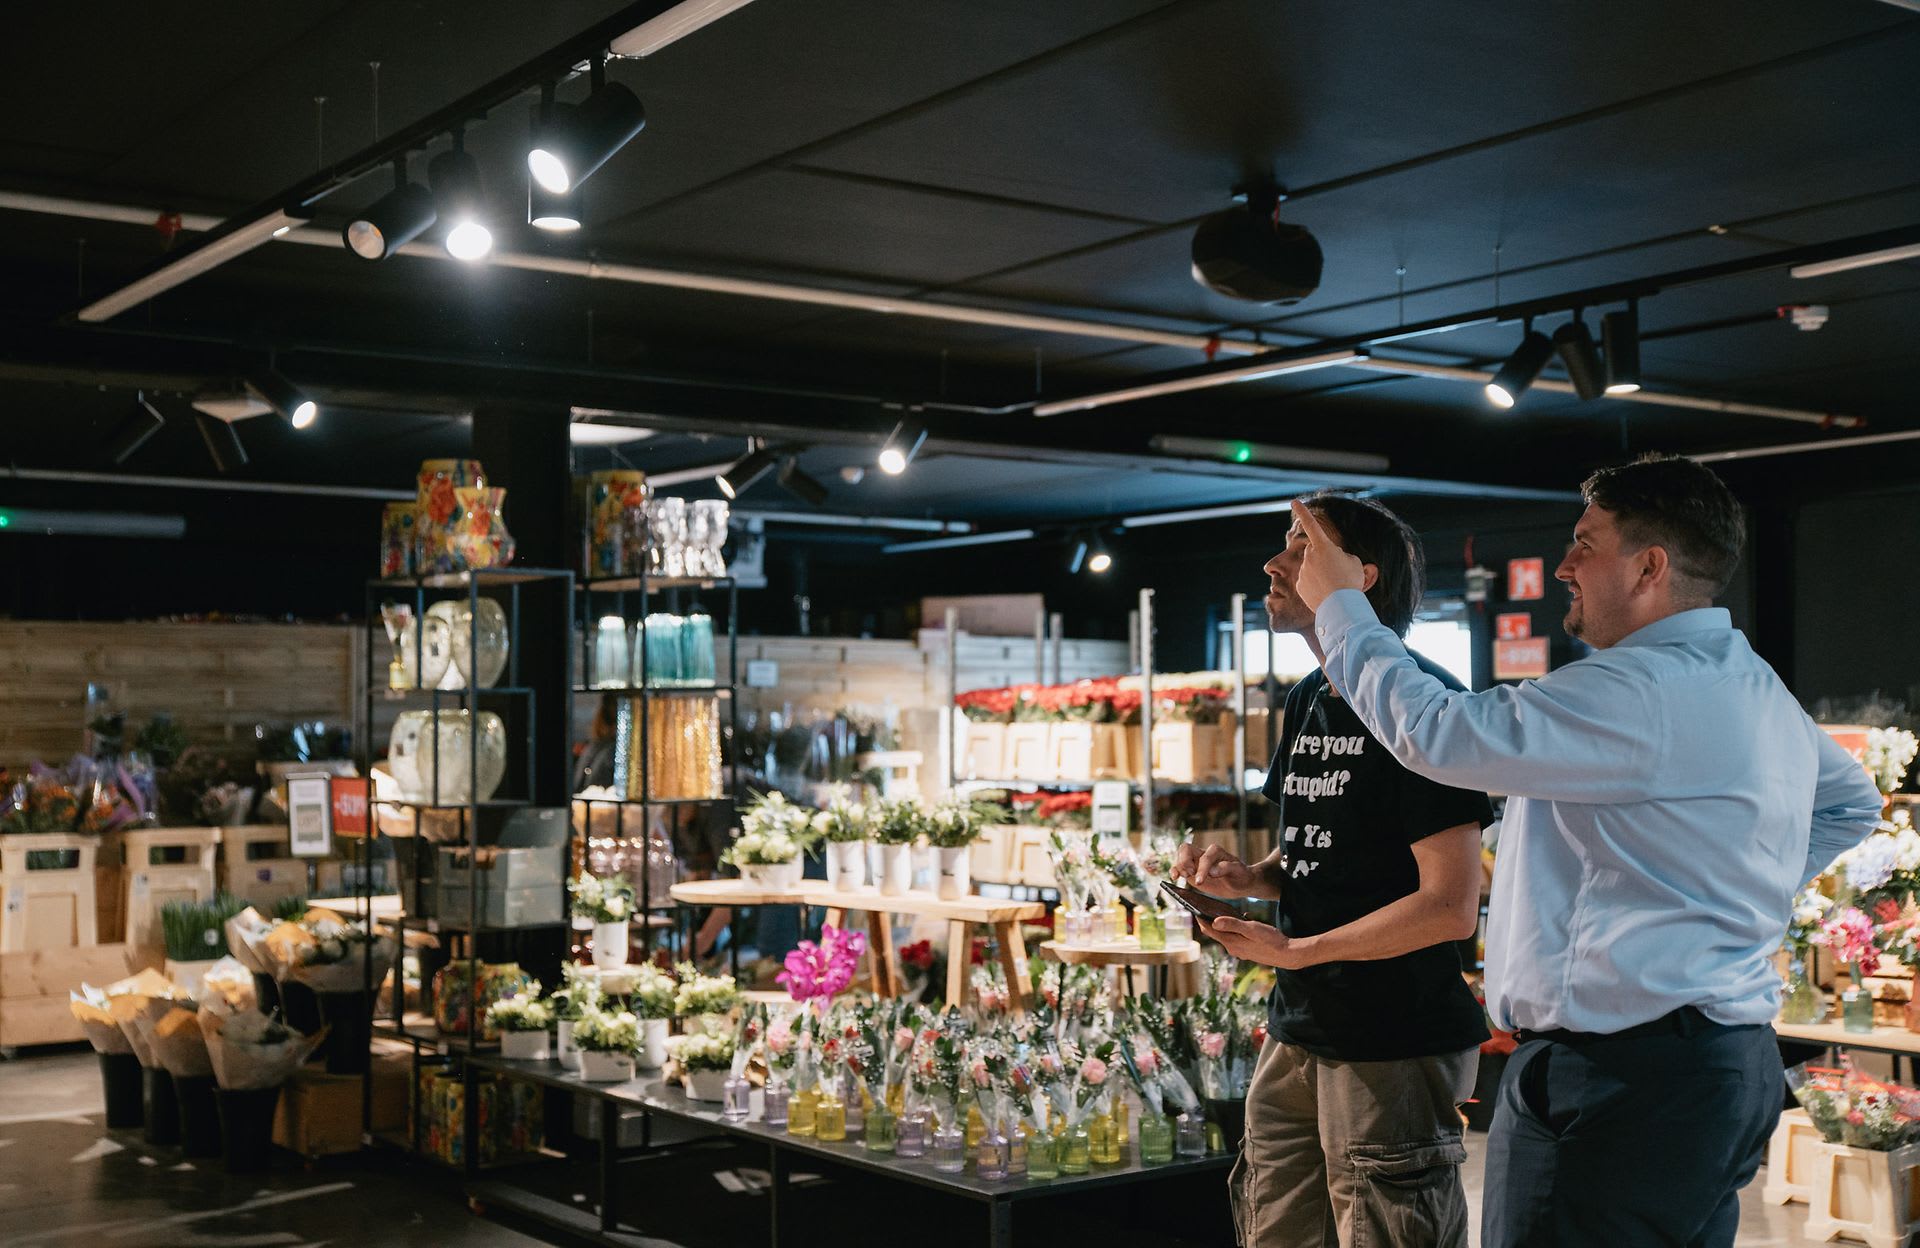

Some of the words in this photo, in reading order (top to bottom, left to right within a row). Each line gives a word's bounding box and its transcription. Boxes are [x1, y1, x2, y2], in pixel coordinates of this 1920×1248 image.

[1291, 732, 1321, 755] re
[1321, 735, 1365, 761] you
[1283, 769, 1351, 802] tupid?
[1304, 824, 1332, 848] Yes
